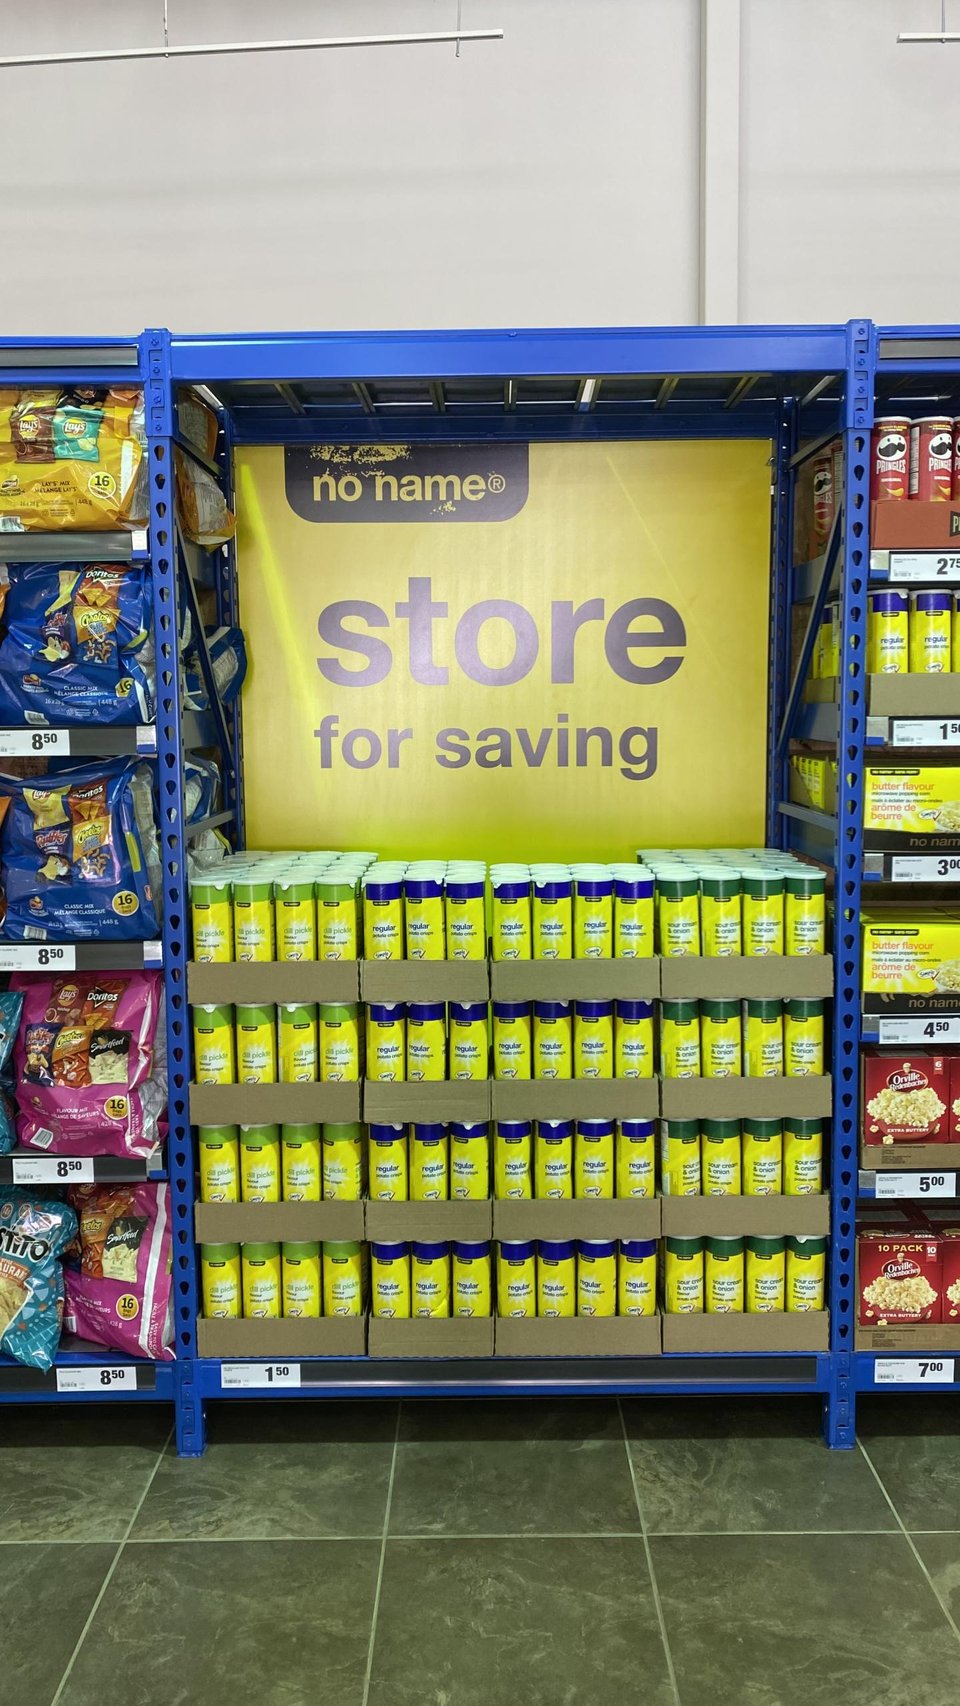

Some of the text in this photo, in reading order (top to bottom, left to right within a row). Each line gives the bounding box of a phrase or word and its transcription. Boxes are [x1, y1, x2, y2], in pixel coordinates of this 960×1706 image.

[64, 422, 86, 432] Lay's
[876, 459, 906, 474] PRINGLES
[95, 476, 109, 486] 16
[313, 472, 362, 502] no
[86, 570, 119, 579] Doritos
[317, 577, 687, 687] store
[880, 637, 904, 645] regular
[924, 635, 948, 644] regular
[120, 680, 132, 693] 16
[940, 723, 960, 740] 15
[314, 713, 658, 781] for saving
[871, 782, 935, 790] butter flavour
[871, 803, 916, 811] arôme de
[871, 812, 902, 820] beurre
[36, 830, 68, 848] Ruffles
[910, 838, 927, 846] no
[118, 894, 132, 905] 16
[373, 925, 396, 933] regular
[451, 923, 473, 931] regular
[540, 923, 564, 931] regular
[584, 921, 607, 929] regular
[620, 923, 644, 931] regular
[872, 941, 934, 950] butter flavour
[872, 962, 916, 971] arôme de
[59, 990, 77, 1000] Lay's
[87, 993, 118, 1001] Doritos
[908, 1000, 925, 1008] no
[57, 1032, 84, 1048] Cheetos
[90, 1038, 124, 1052] Smartfood
[409, 1044, 430, 1052] regular
[455, 1045, 478, 1053] regular
[498, 1042, 522, 1050] regular
[540, 1042, 563, 1050] regular
[581, 1041, 605, 1049] regular
[622, 1043, 645, 1051] regular
[377, 1046, 400, 1054] regular
[893, 1072, 920, 1085] Orville
[110, 1100, 124, 1109] 16
[376, 1165, 399, 1173] regular
[422, 1164, 444, 1173] regular
[453, 1161, 474, 1170] regular
[505, 1162, 528, 1170] regular
[583, 1161, 606, 1169] regular
[628, 1161, 652, 1169] regular
[107, 1230, 138, 1244] Smartfood
[888, 1262, 913, 1273] Orville
[377, 1283, 400, 1291] regular
[416, 1282, 438, 1290] regular
[456, 1282, 479, 1290] regular
[508, 1284, 531, 1292] regular
[542, 1283, 565, 1291] regular
[580, 1280, 601, 1288] regular
[625, 1281, 649, 1289] regular
[122, 1298, 134, 1308] 16
